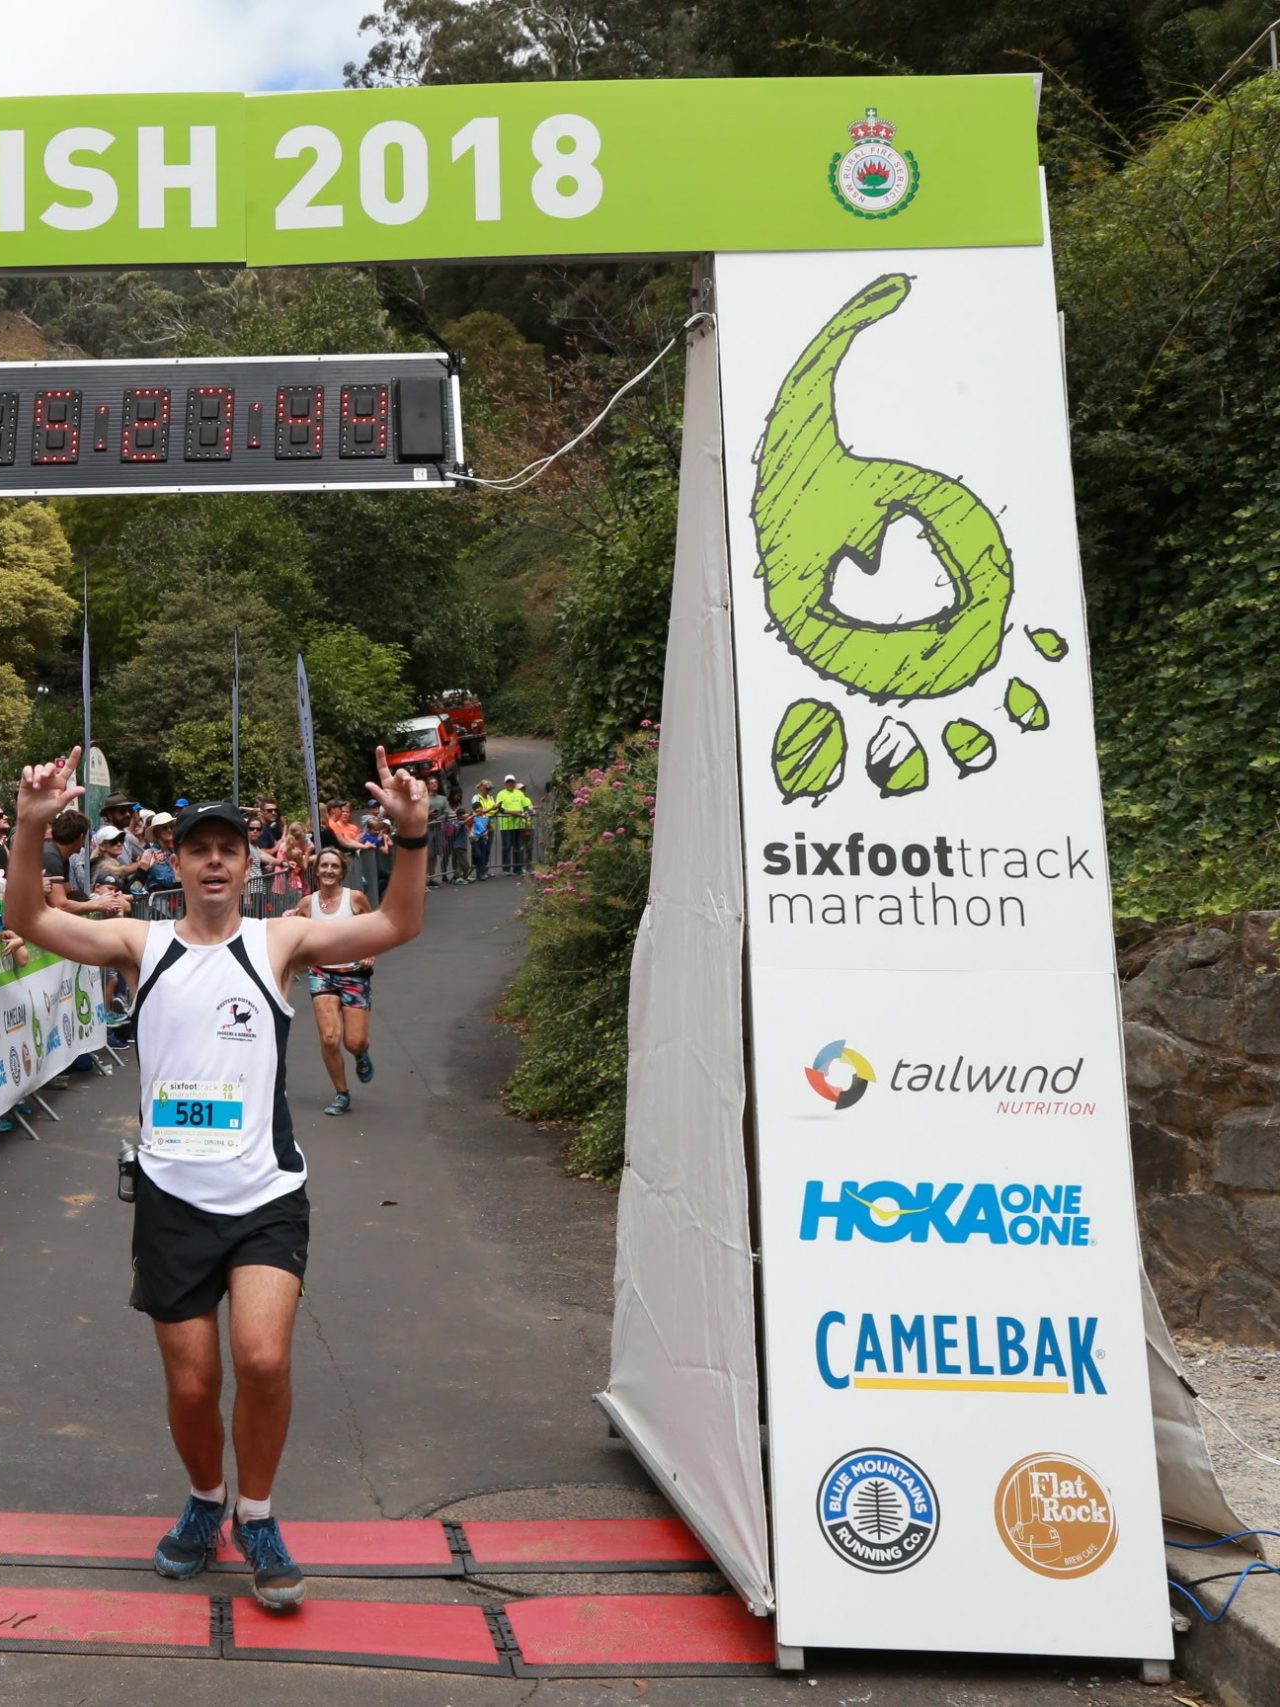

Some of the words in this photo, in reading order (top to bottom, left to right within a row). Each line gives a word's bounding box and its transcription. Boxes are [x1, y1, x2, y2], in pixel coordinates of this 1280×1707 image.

[274, 113, 604, 231] 2018
[844, 150, 867, 179] RURAL
[870, 147, 894, 160] FIRE
[882, 161, 904, 203] SERVICE
[768, 882, 1025, 927] marathon
[890, 1056, 1084, 1094] tailwind
[175, 1101, 214, 1126] 581
[996, 1101, 1096, 1116] NUTRITION
[799, 1180, 1008, 1246] HOKA
[1000, 1183, 1082, 1215] ONE
[1008, 1215, 1091, 1246] ONE
[815, 1310, 1109, 1396] CAMELBAK
[829, 1472, 852, 1512] BLUE
[850, 1460, 927, 1514] MOUNTAINS
[1029, 1471, 1087, 1499] Flat
[1040, 1497, 1109, 1523] Rock
[836, 1526, 903, 1561] RUNNING
[903, 1532, 924, 1551] CO.
[1064, 1553, 1083, 1566] BREW
